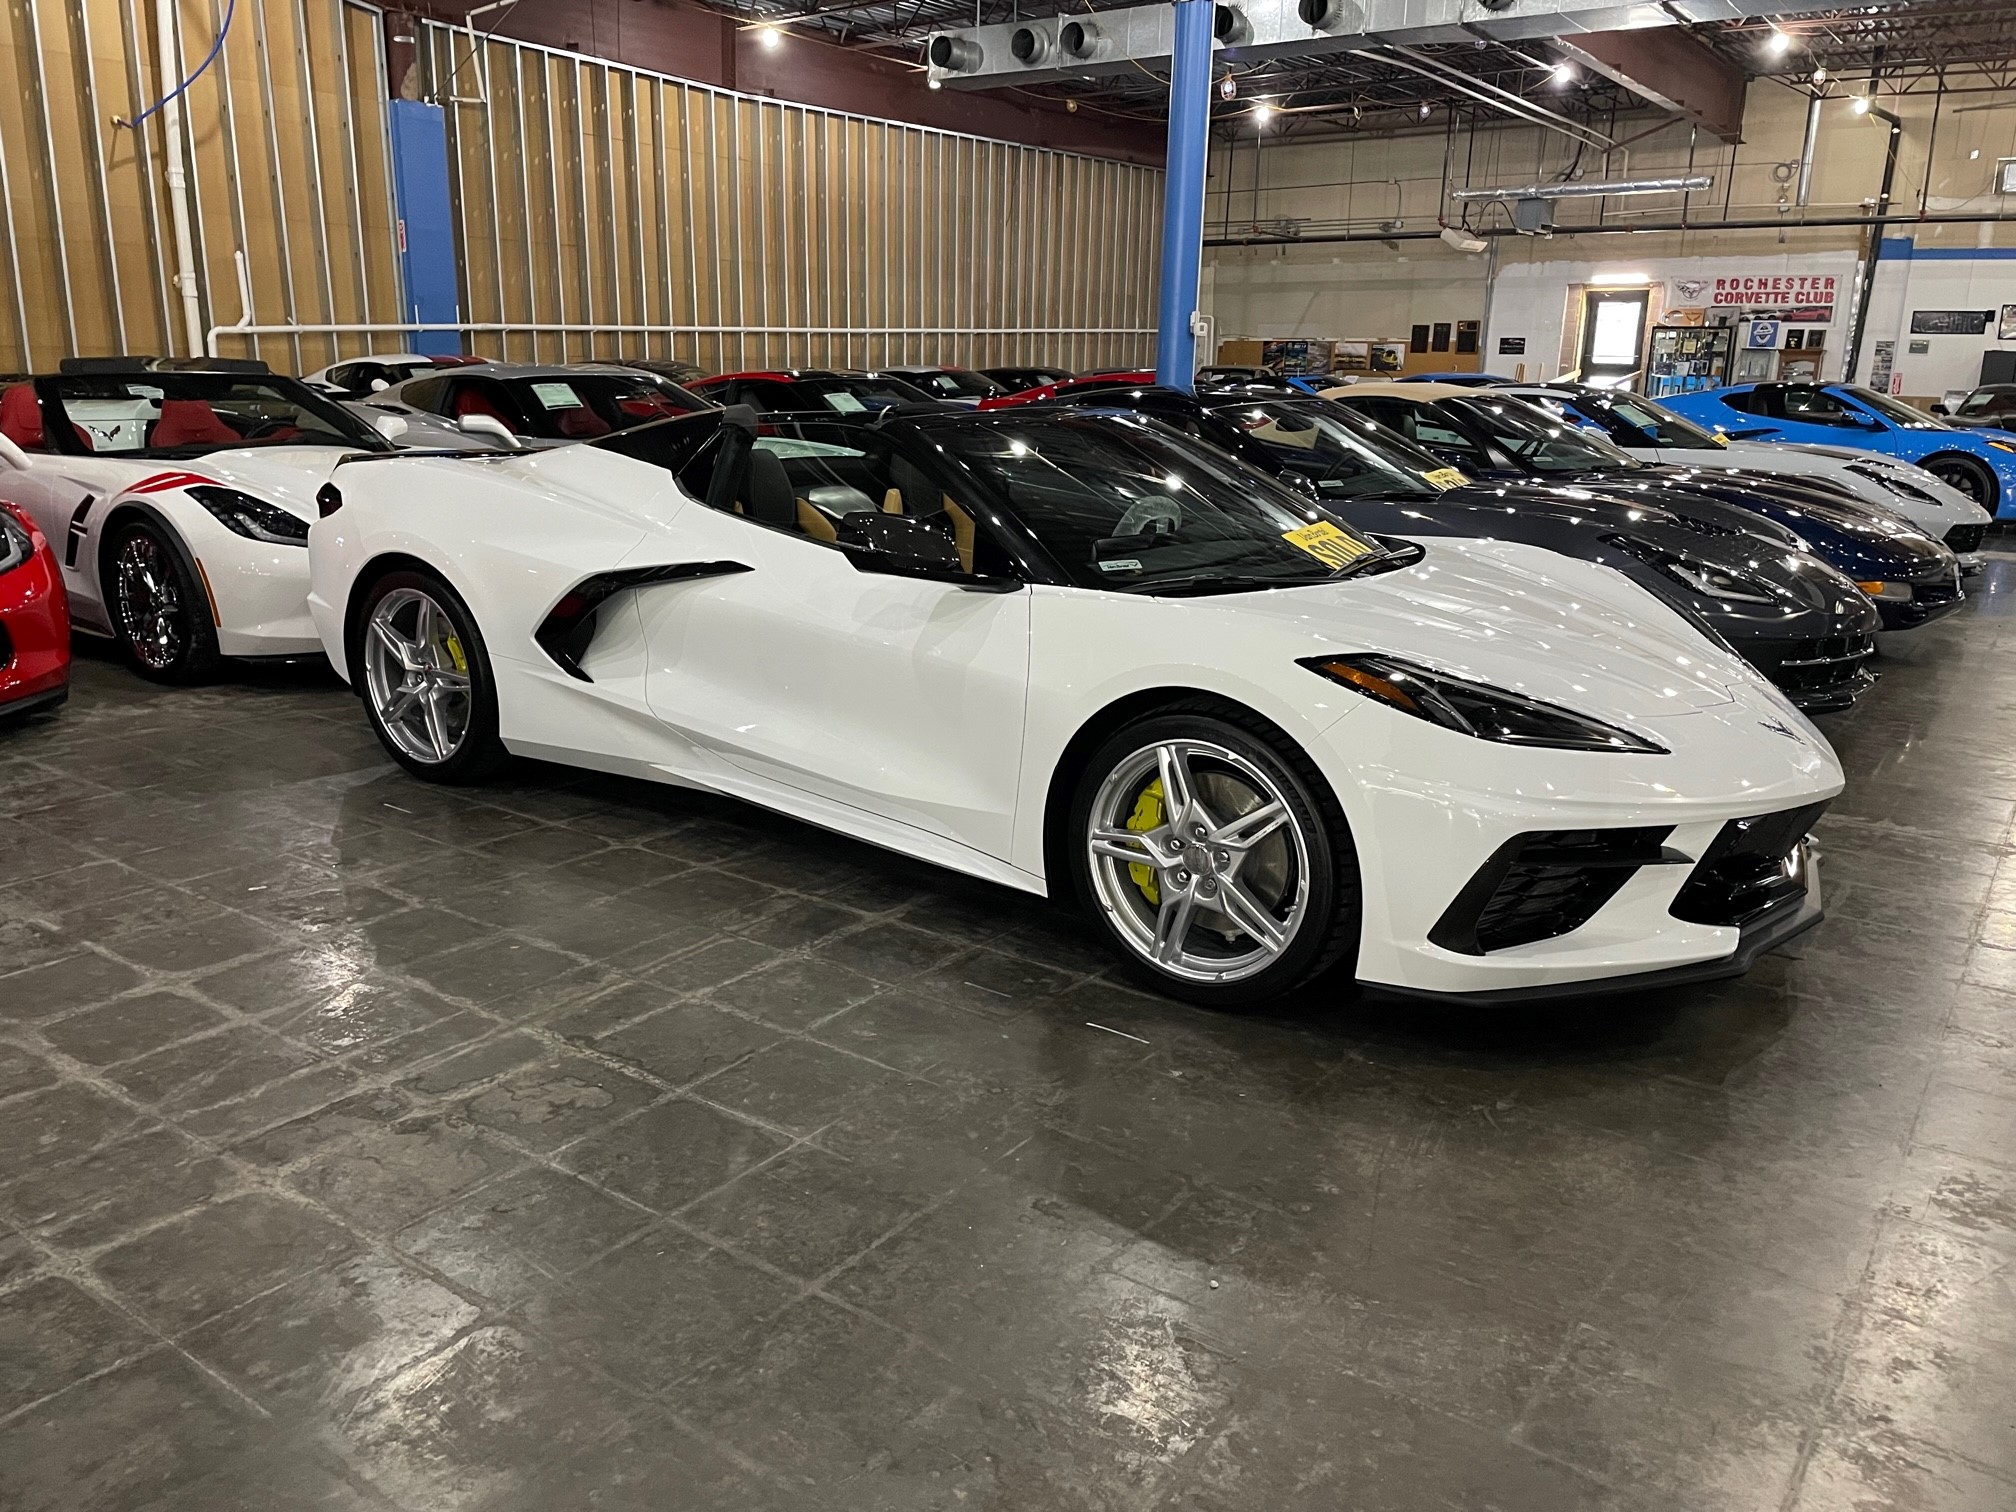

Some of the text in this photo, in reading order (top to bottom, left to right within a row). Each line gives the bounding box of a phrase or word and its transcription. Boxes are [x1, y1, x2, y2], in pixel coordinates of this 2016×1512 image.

[1715, 277, 1835, 291] ROCHESTER
[1713, 291, 1834, 305] CORVETTE CLUB
